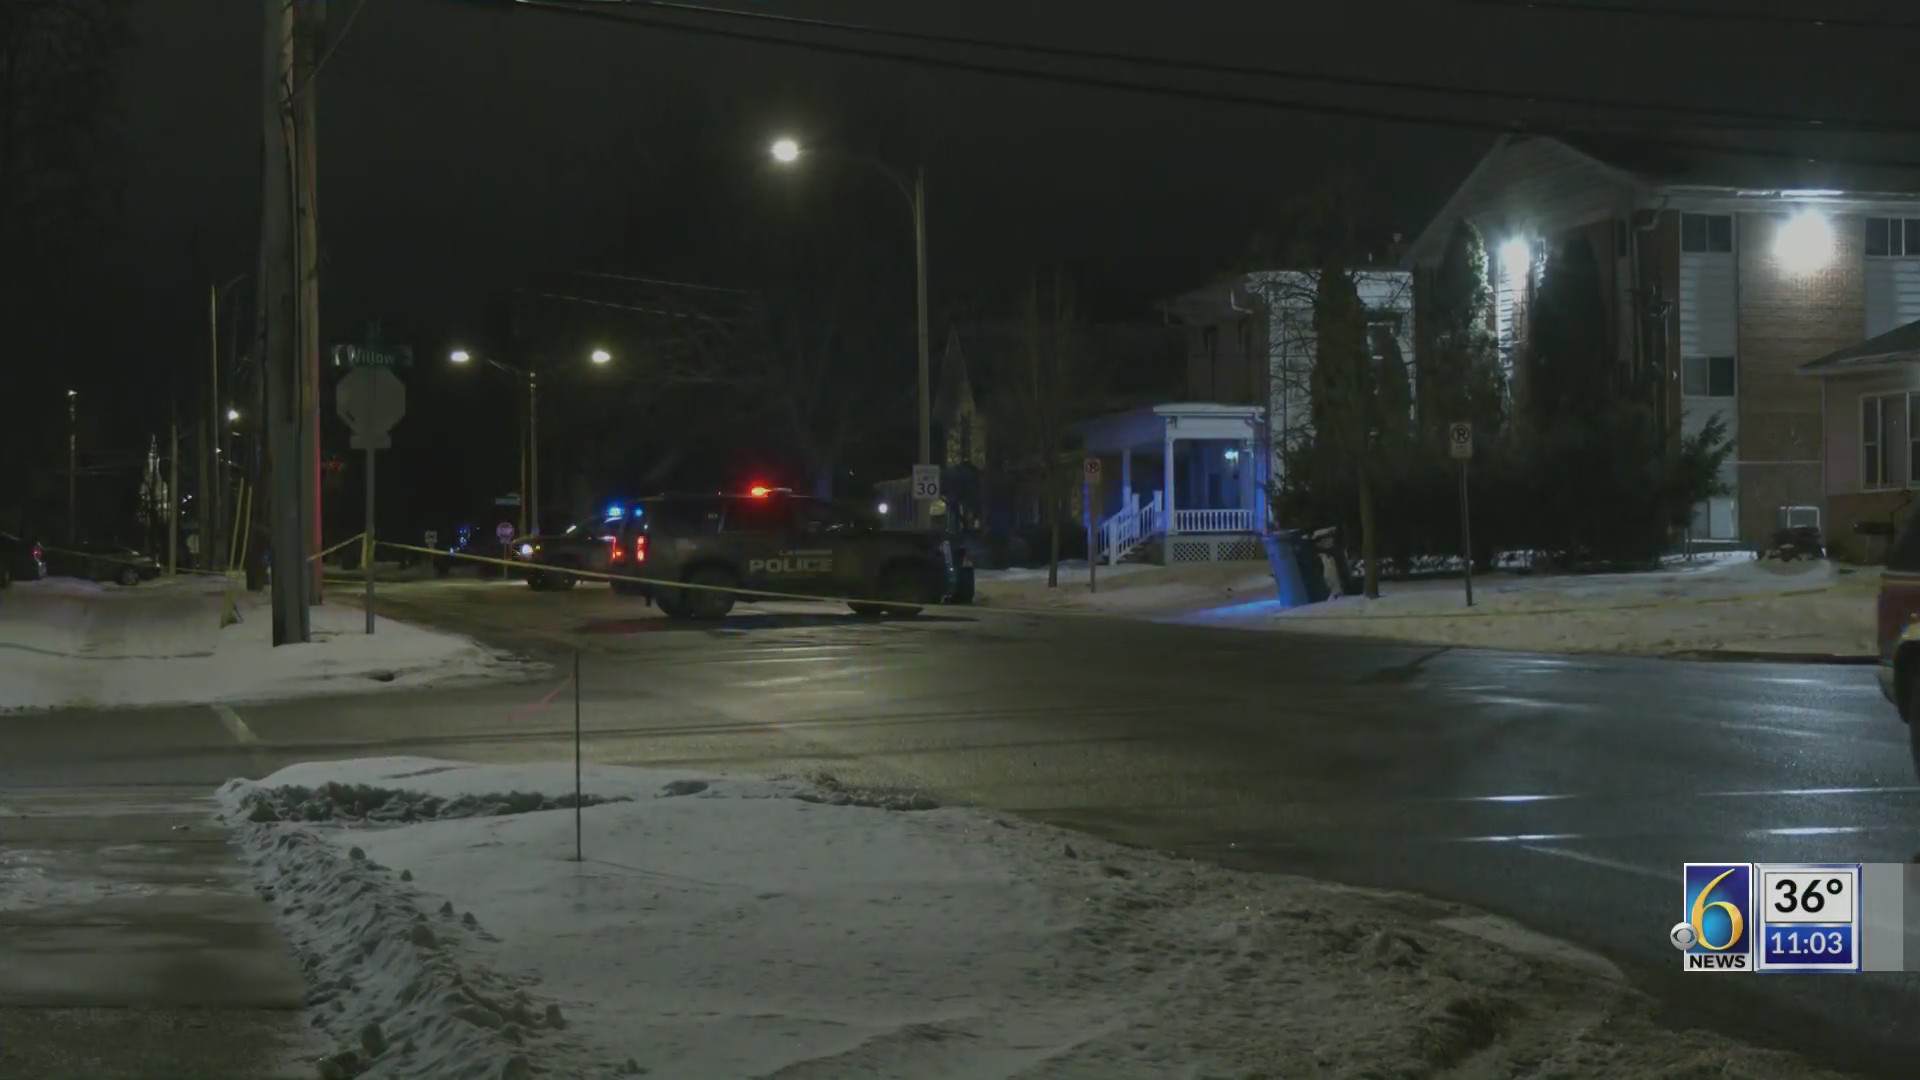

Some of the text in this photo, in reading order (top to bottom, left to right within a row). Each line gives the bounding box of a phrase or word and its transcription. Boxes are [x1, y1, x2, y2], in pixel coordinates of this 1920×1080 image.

[346, 344, 395, 365] Willow
[916, 482, 937, 496] 30
[749, 558, 833, 573] POLICE
